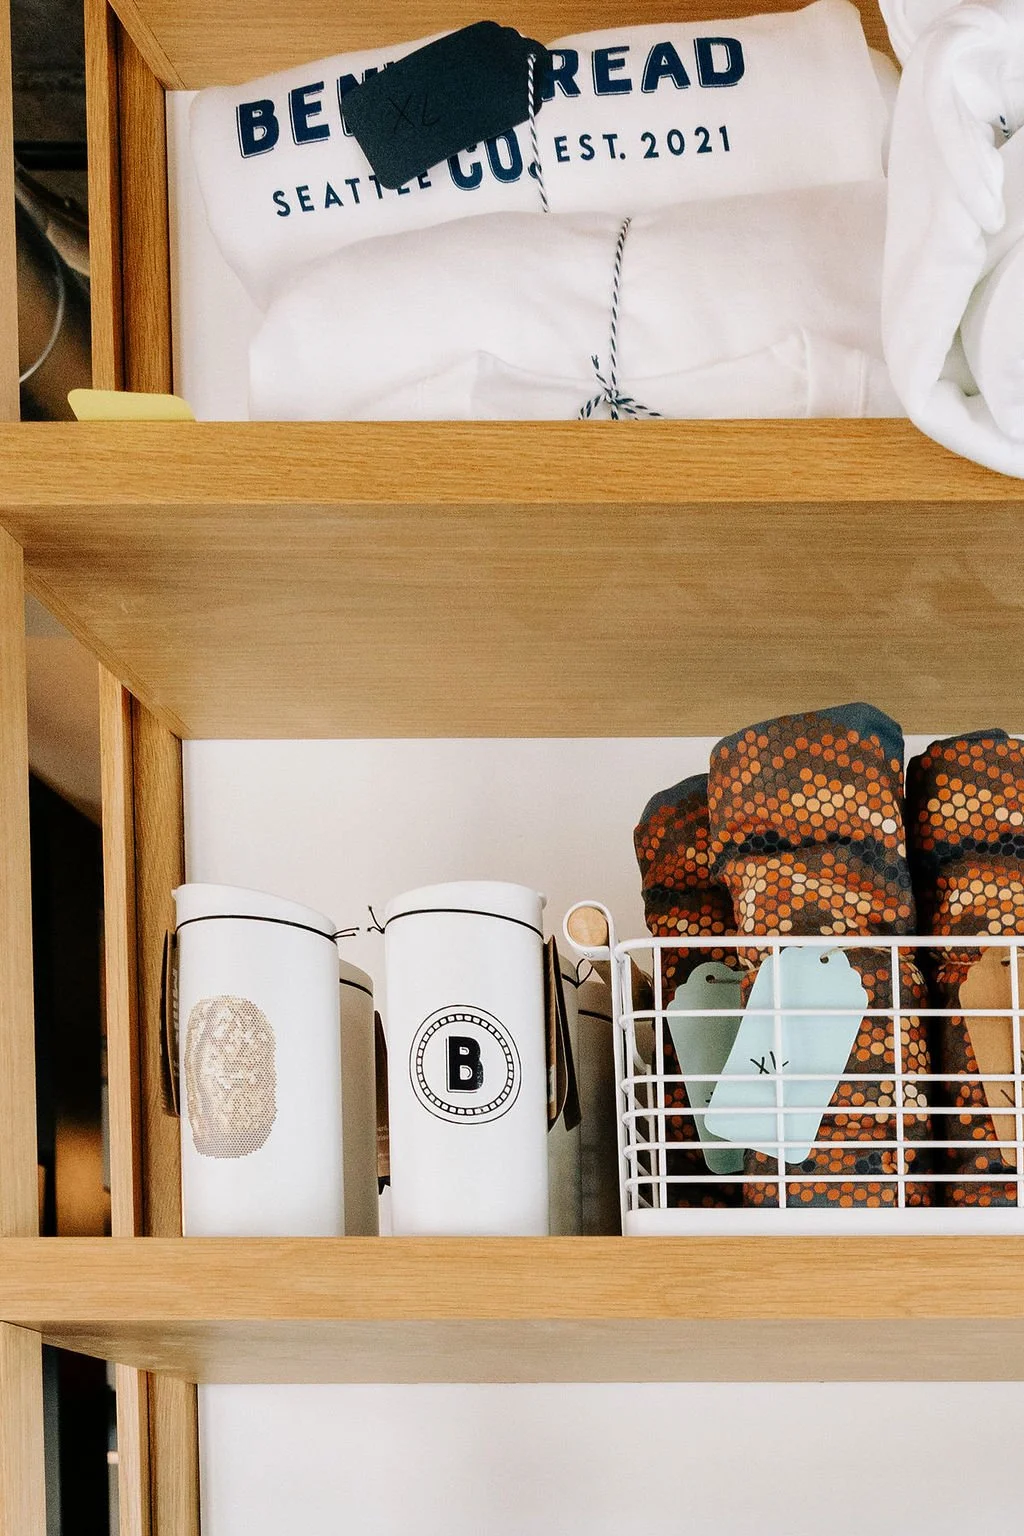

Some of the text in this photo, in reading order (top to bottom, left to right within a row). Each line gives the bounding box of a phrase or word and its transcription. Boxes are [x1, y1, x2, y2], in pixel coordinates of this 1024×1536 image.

[541, 37, 746, 102] READ
[272, 168, 432, 217] SEATTE
[554, 133, 627, 163] EST.
[641, 125, 731, 160] 2021
[446, 1036, 483, 1093] B
